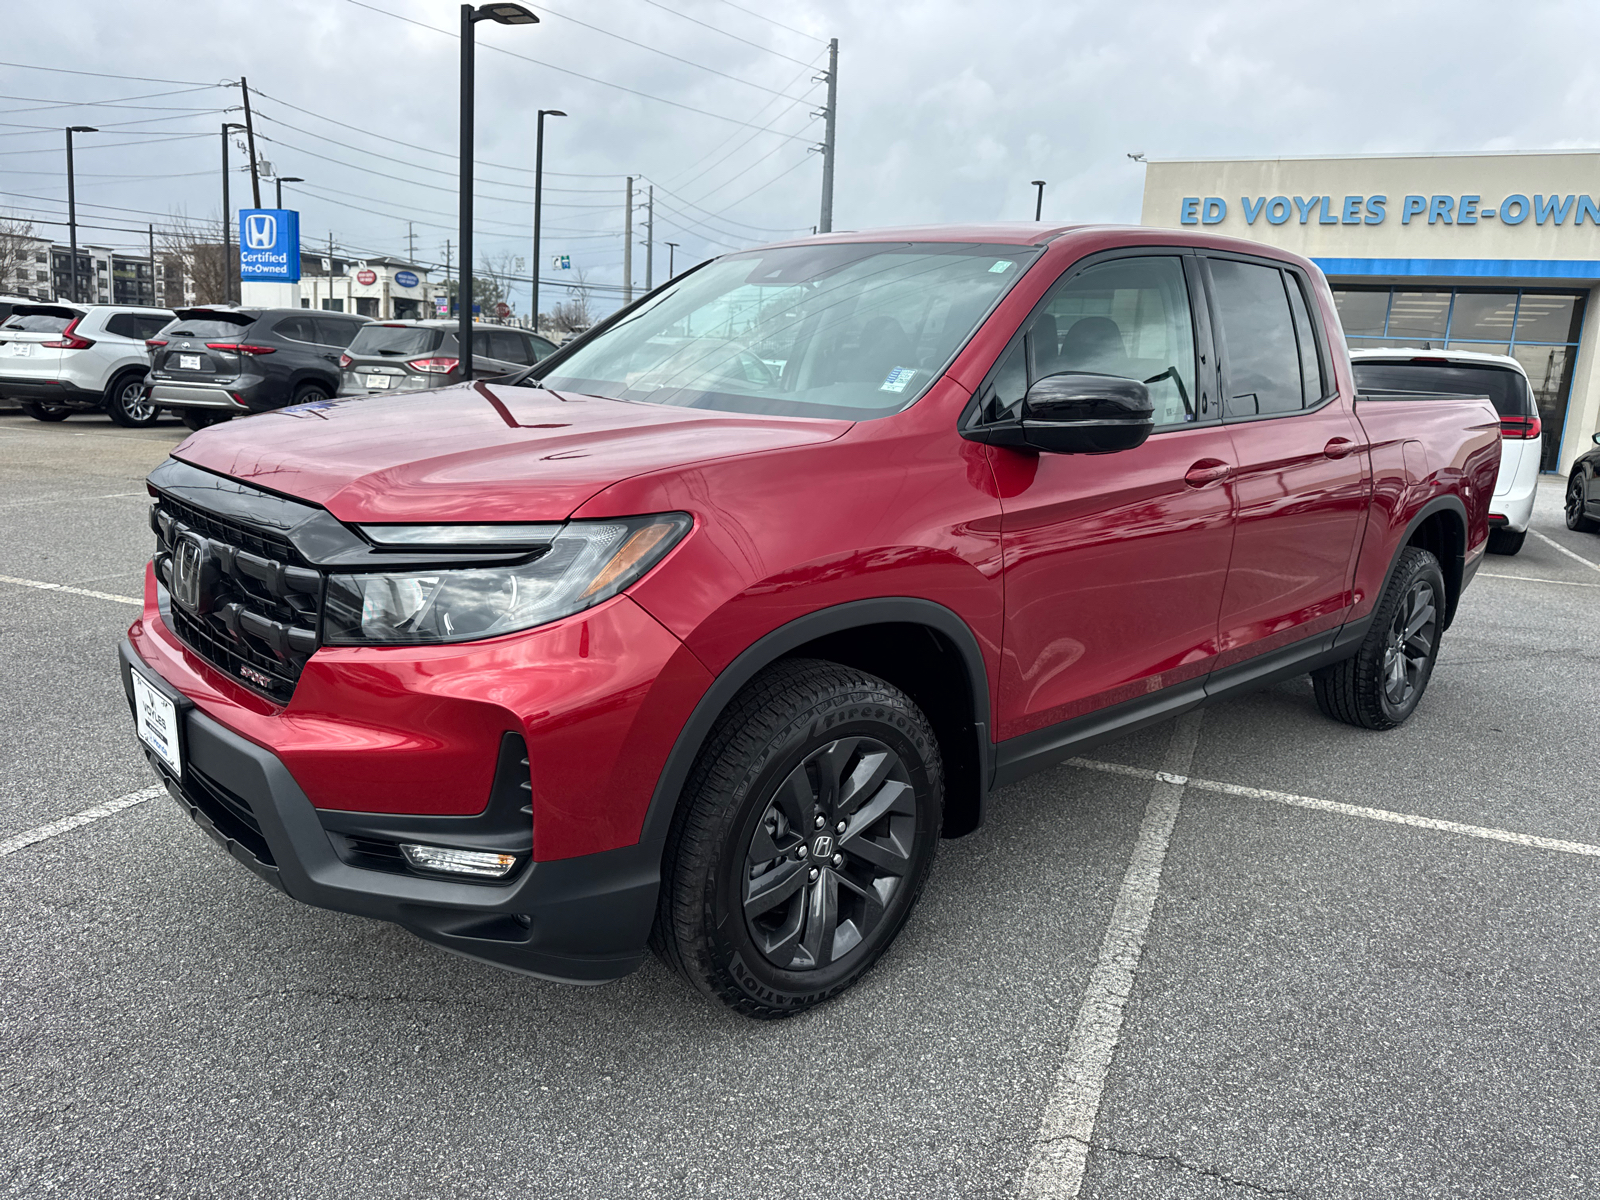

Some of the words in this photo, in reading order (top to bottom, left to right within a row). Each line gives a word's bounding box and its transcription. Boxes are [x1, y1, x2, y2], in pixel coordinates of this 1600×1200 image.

[1180, 196, 1227, 225] ED
[1241, 195, 1388, 225] VOYLES
[241, 251, 287, 263] Certified
[241, 263, 287, 273] Pre-Owned
[240, 665, 271, 688] SPORT
[142, 700, 167, 731] VOYLES
[823, 706, 925, 750] Firestone
